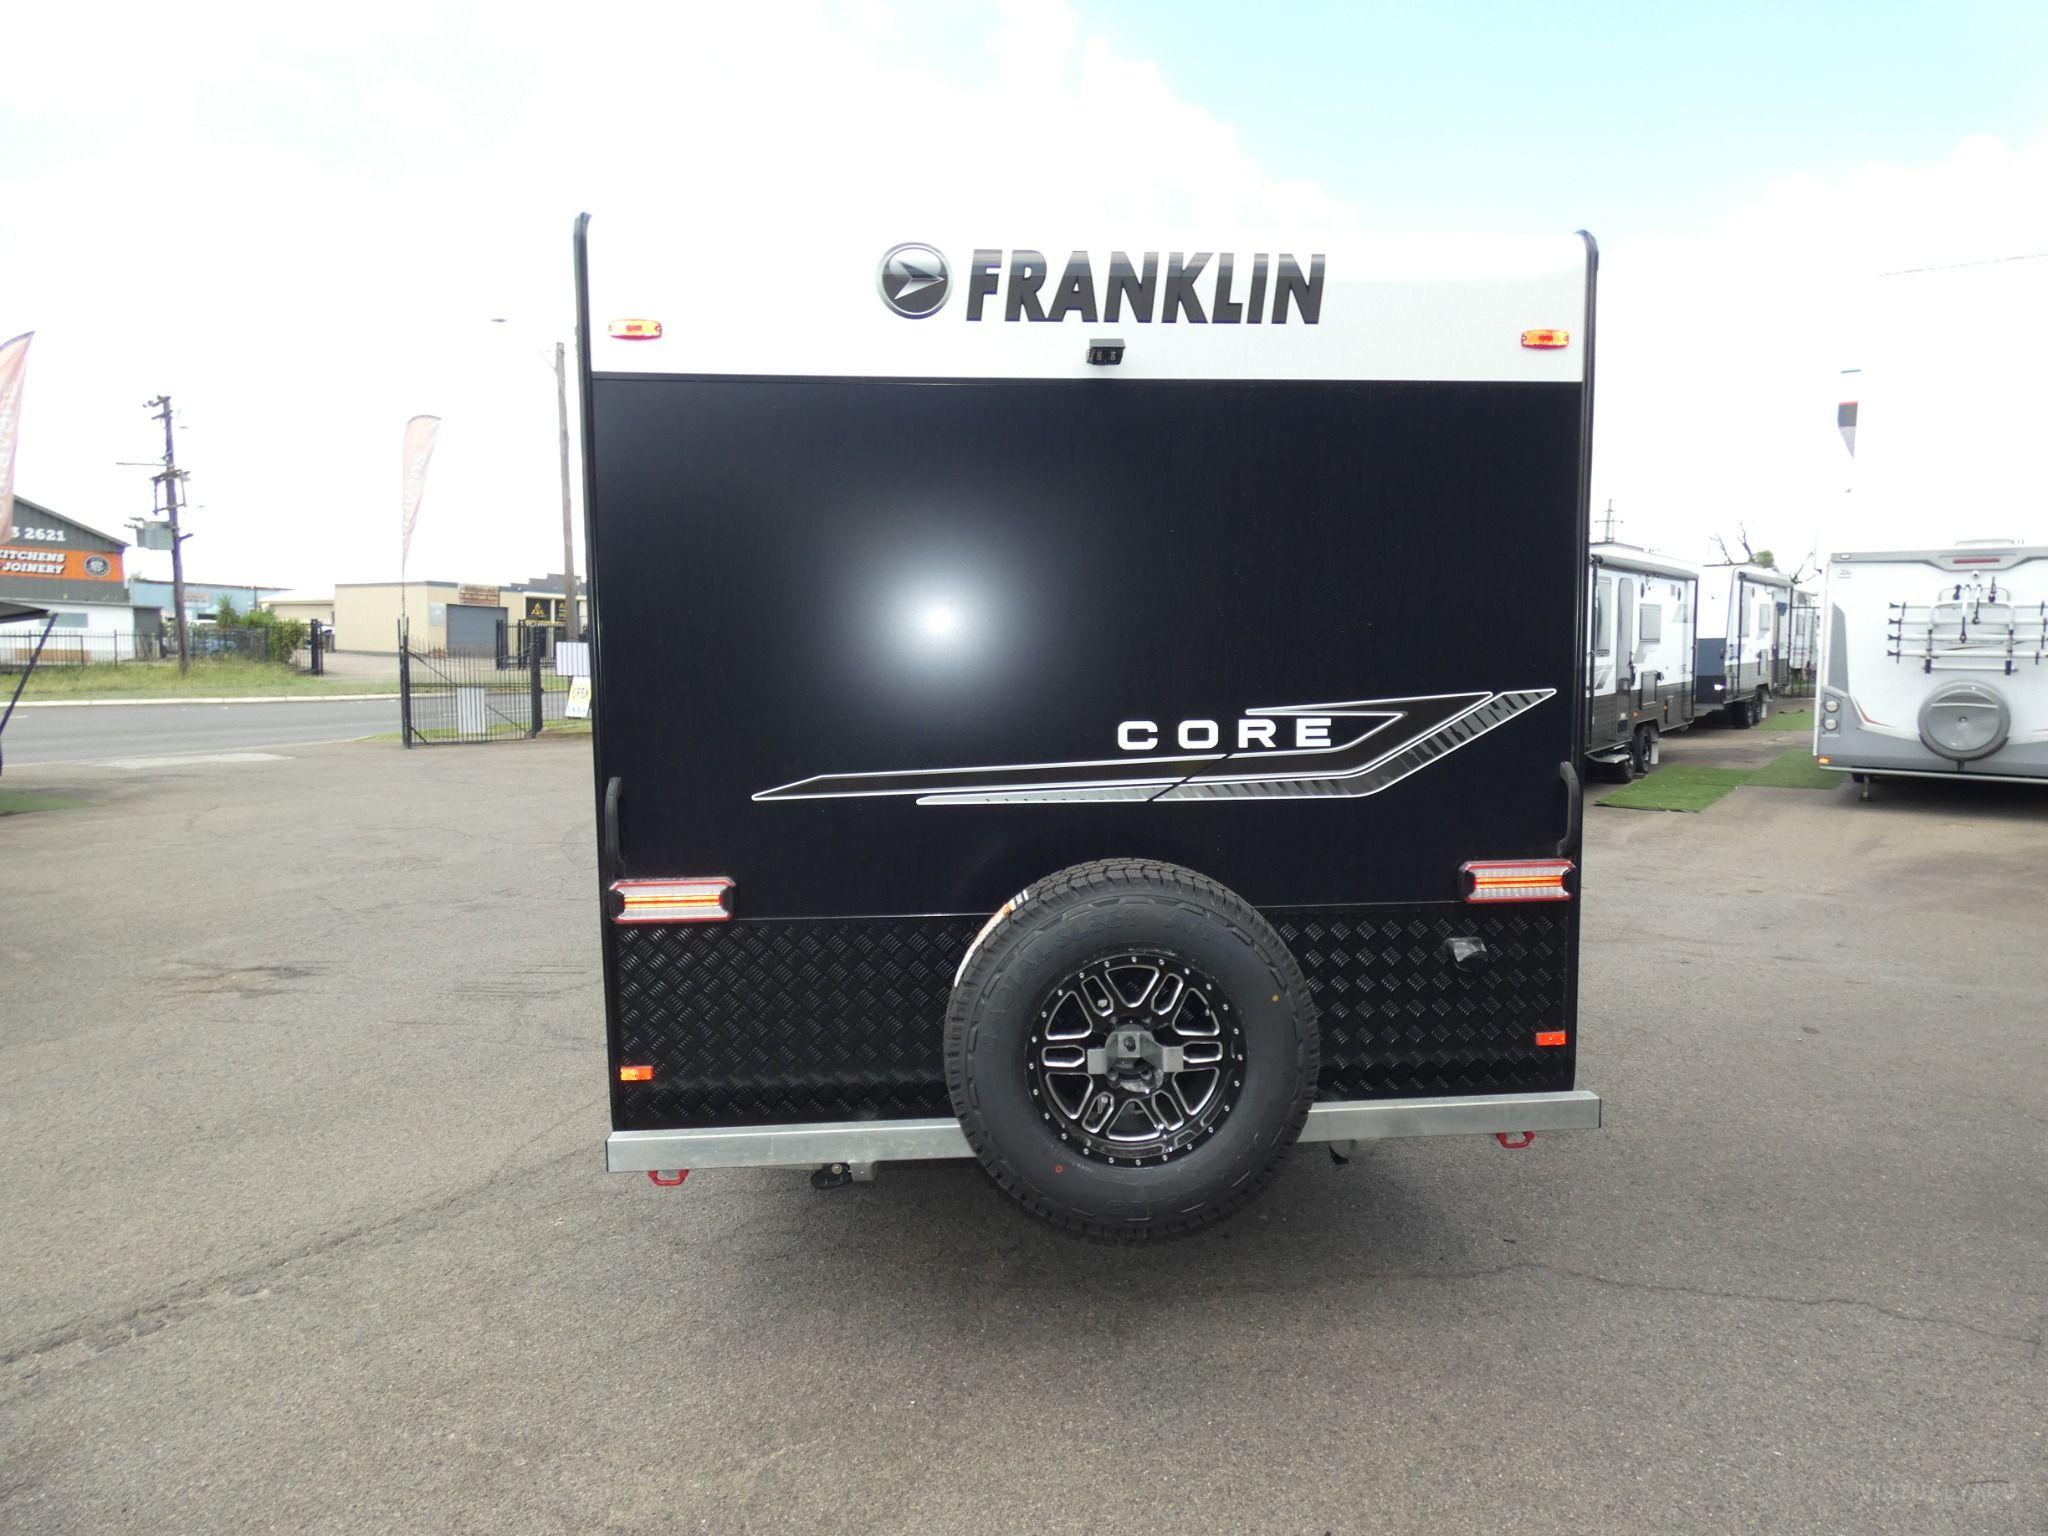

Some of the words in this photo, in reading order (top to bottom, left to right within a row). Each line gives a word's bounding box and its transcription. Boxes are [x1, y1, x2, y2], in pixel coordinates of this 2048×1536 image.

[966, 249, 1326, 325] FRANKLIN
[24, 527, 67, 542] 2621
[1, 561, 65, 575] JOINERY
[1117, 718, 1332, 750] CORE
